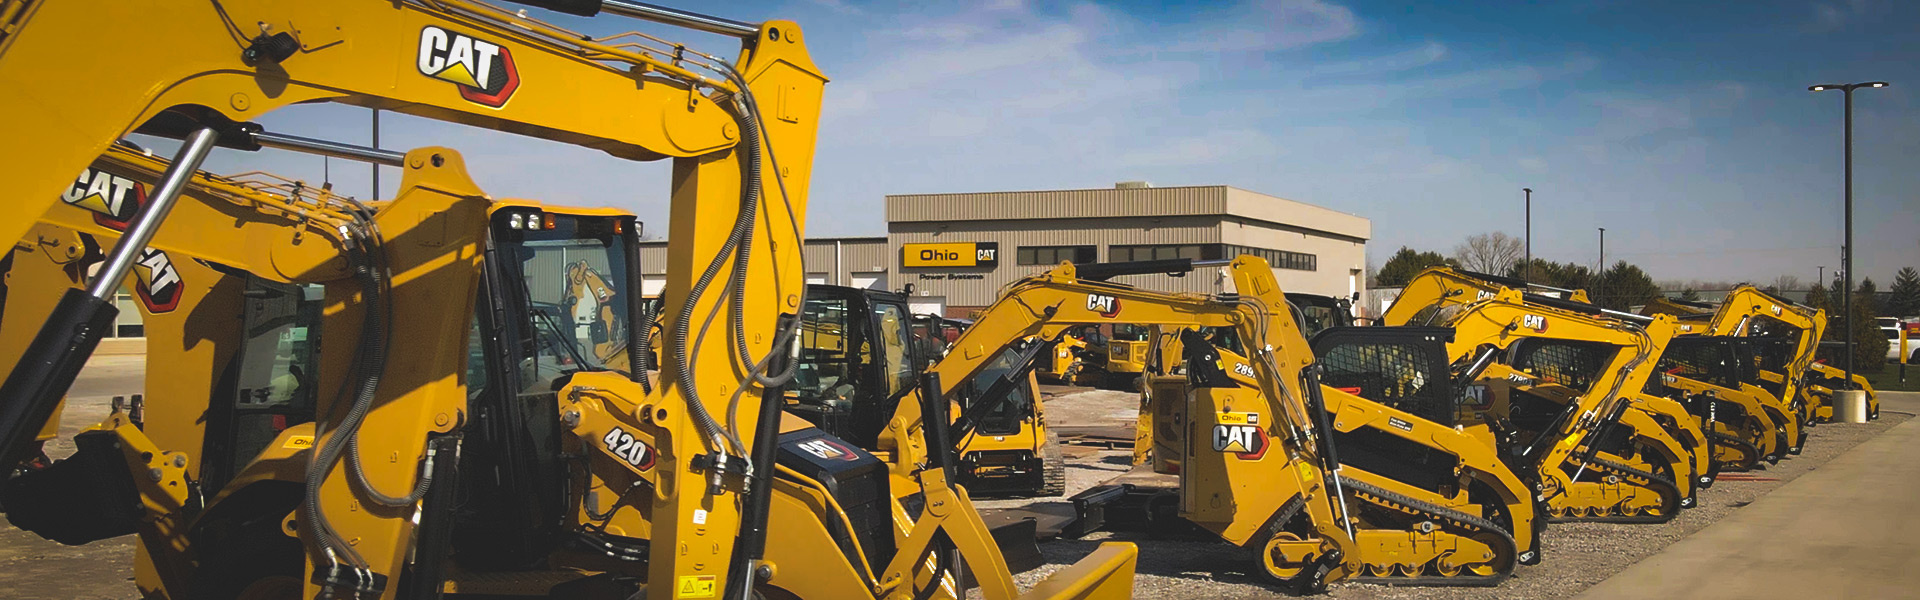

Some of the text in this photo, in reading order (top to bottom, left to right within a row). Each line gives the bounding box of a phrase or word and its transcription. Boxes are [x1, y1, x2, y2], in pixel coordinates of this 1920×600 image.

[418, 26, 500, 90] CAT
[920, 249, 996, 261] Ohio CAT
[1087, 294, 1115, 313] CAT
[1524, 314, 1545, 330] CAT
[1234, 362, 1256, 379] 289
[604, 428, 646, 466] 420
[1213, 425, 1256, 453] CAT
[797, 440, 844, 459] CAT
